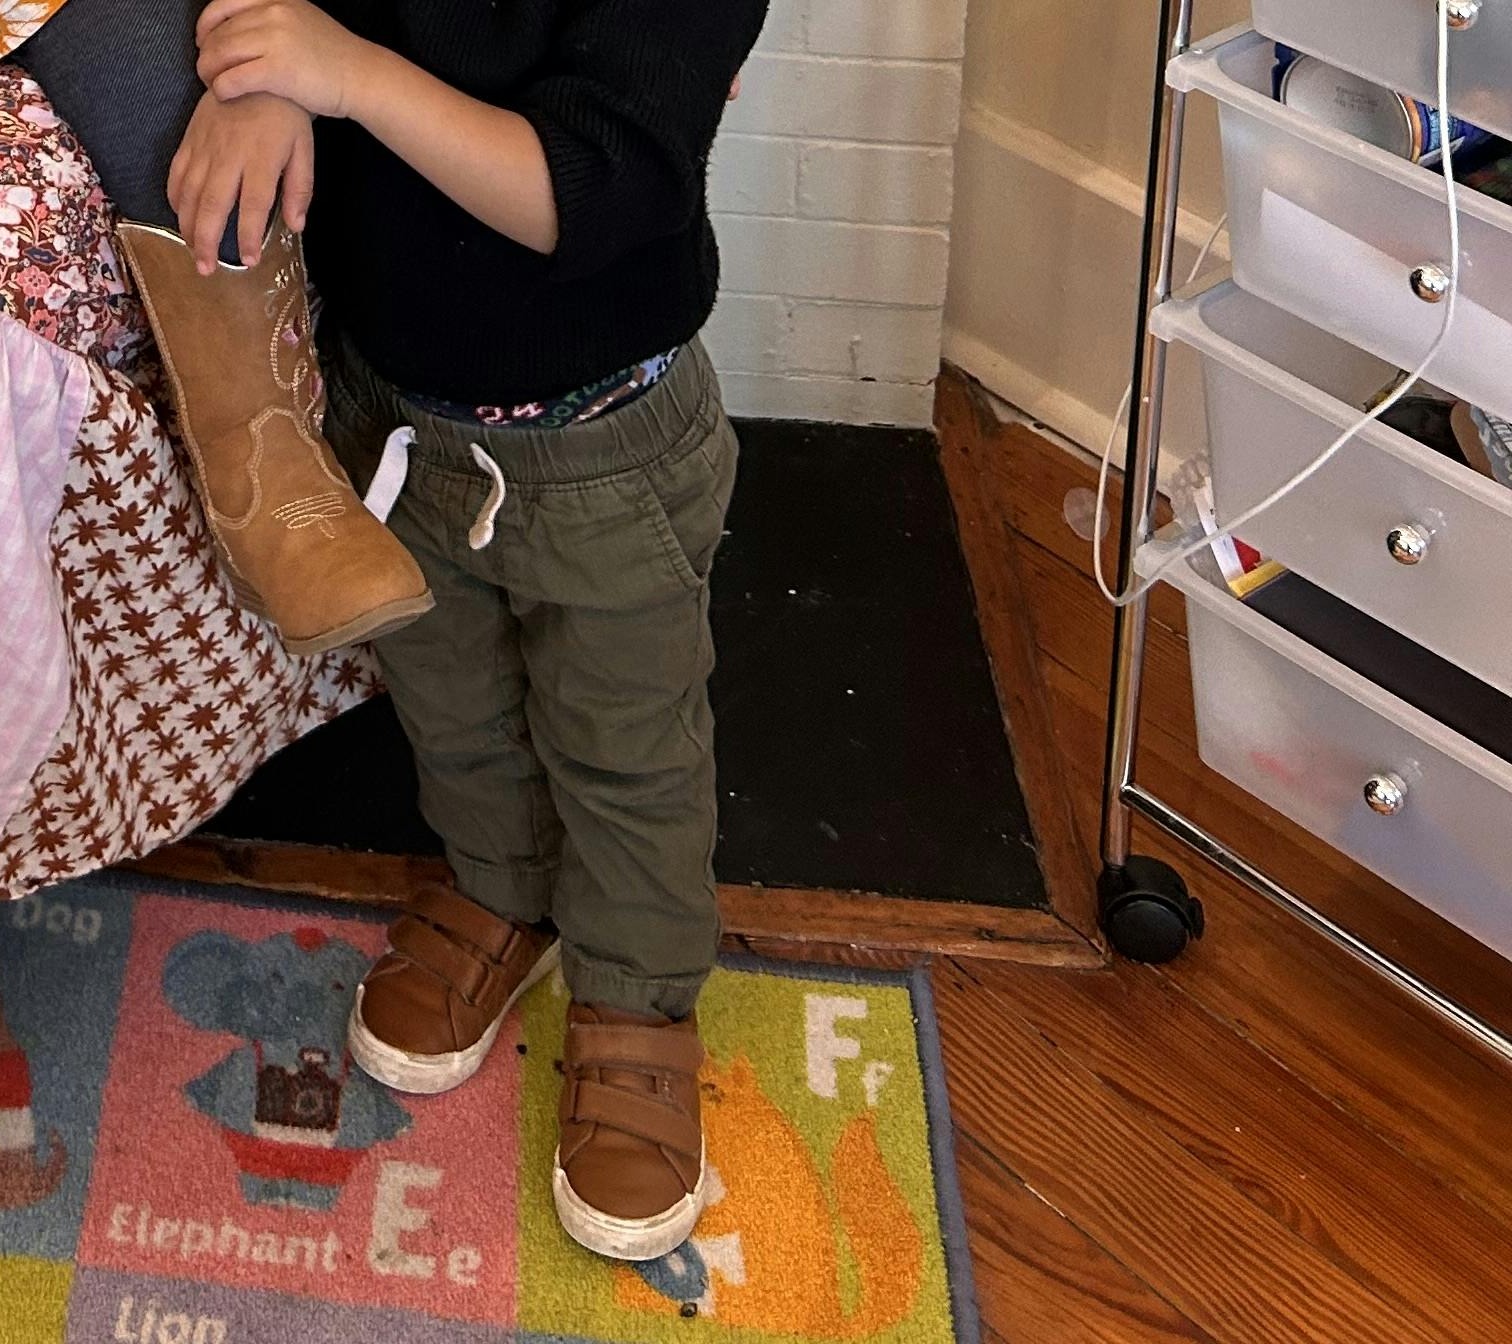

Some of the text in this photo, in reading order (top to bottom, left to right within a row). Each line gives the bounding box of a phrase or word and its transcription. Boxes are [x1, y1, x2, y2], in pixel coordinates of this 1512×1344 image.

[12, 895, 102, 944] Dog
[107, 1203, 341, 1272] Elephant
[113, 1294, 229, 1344] Lion
